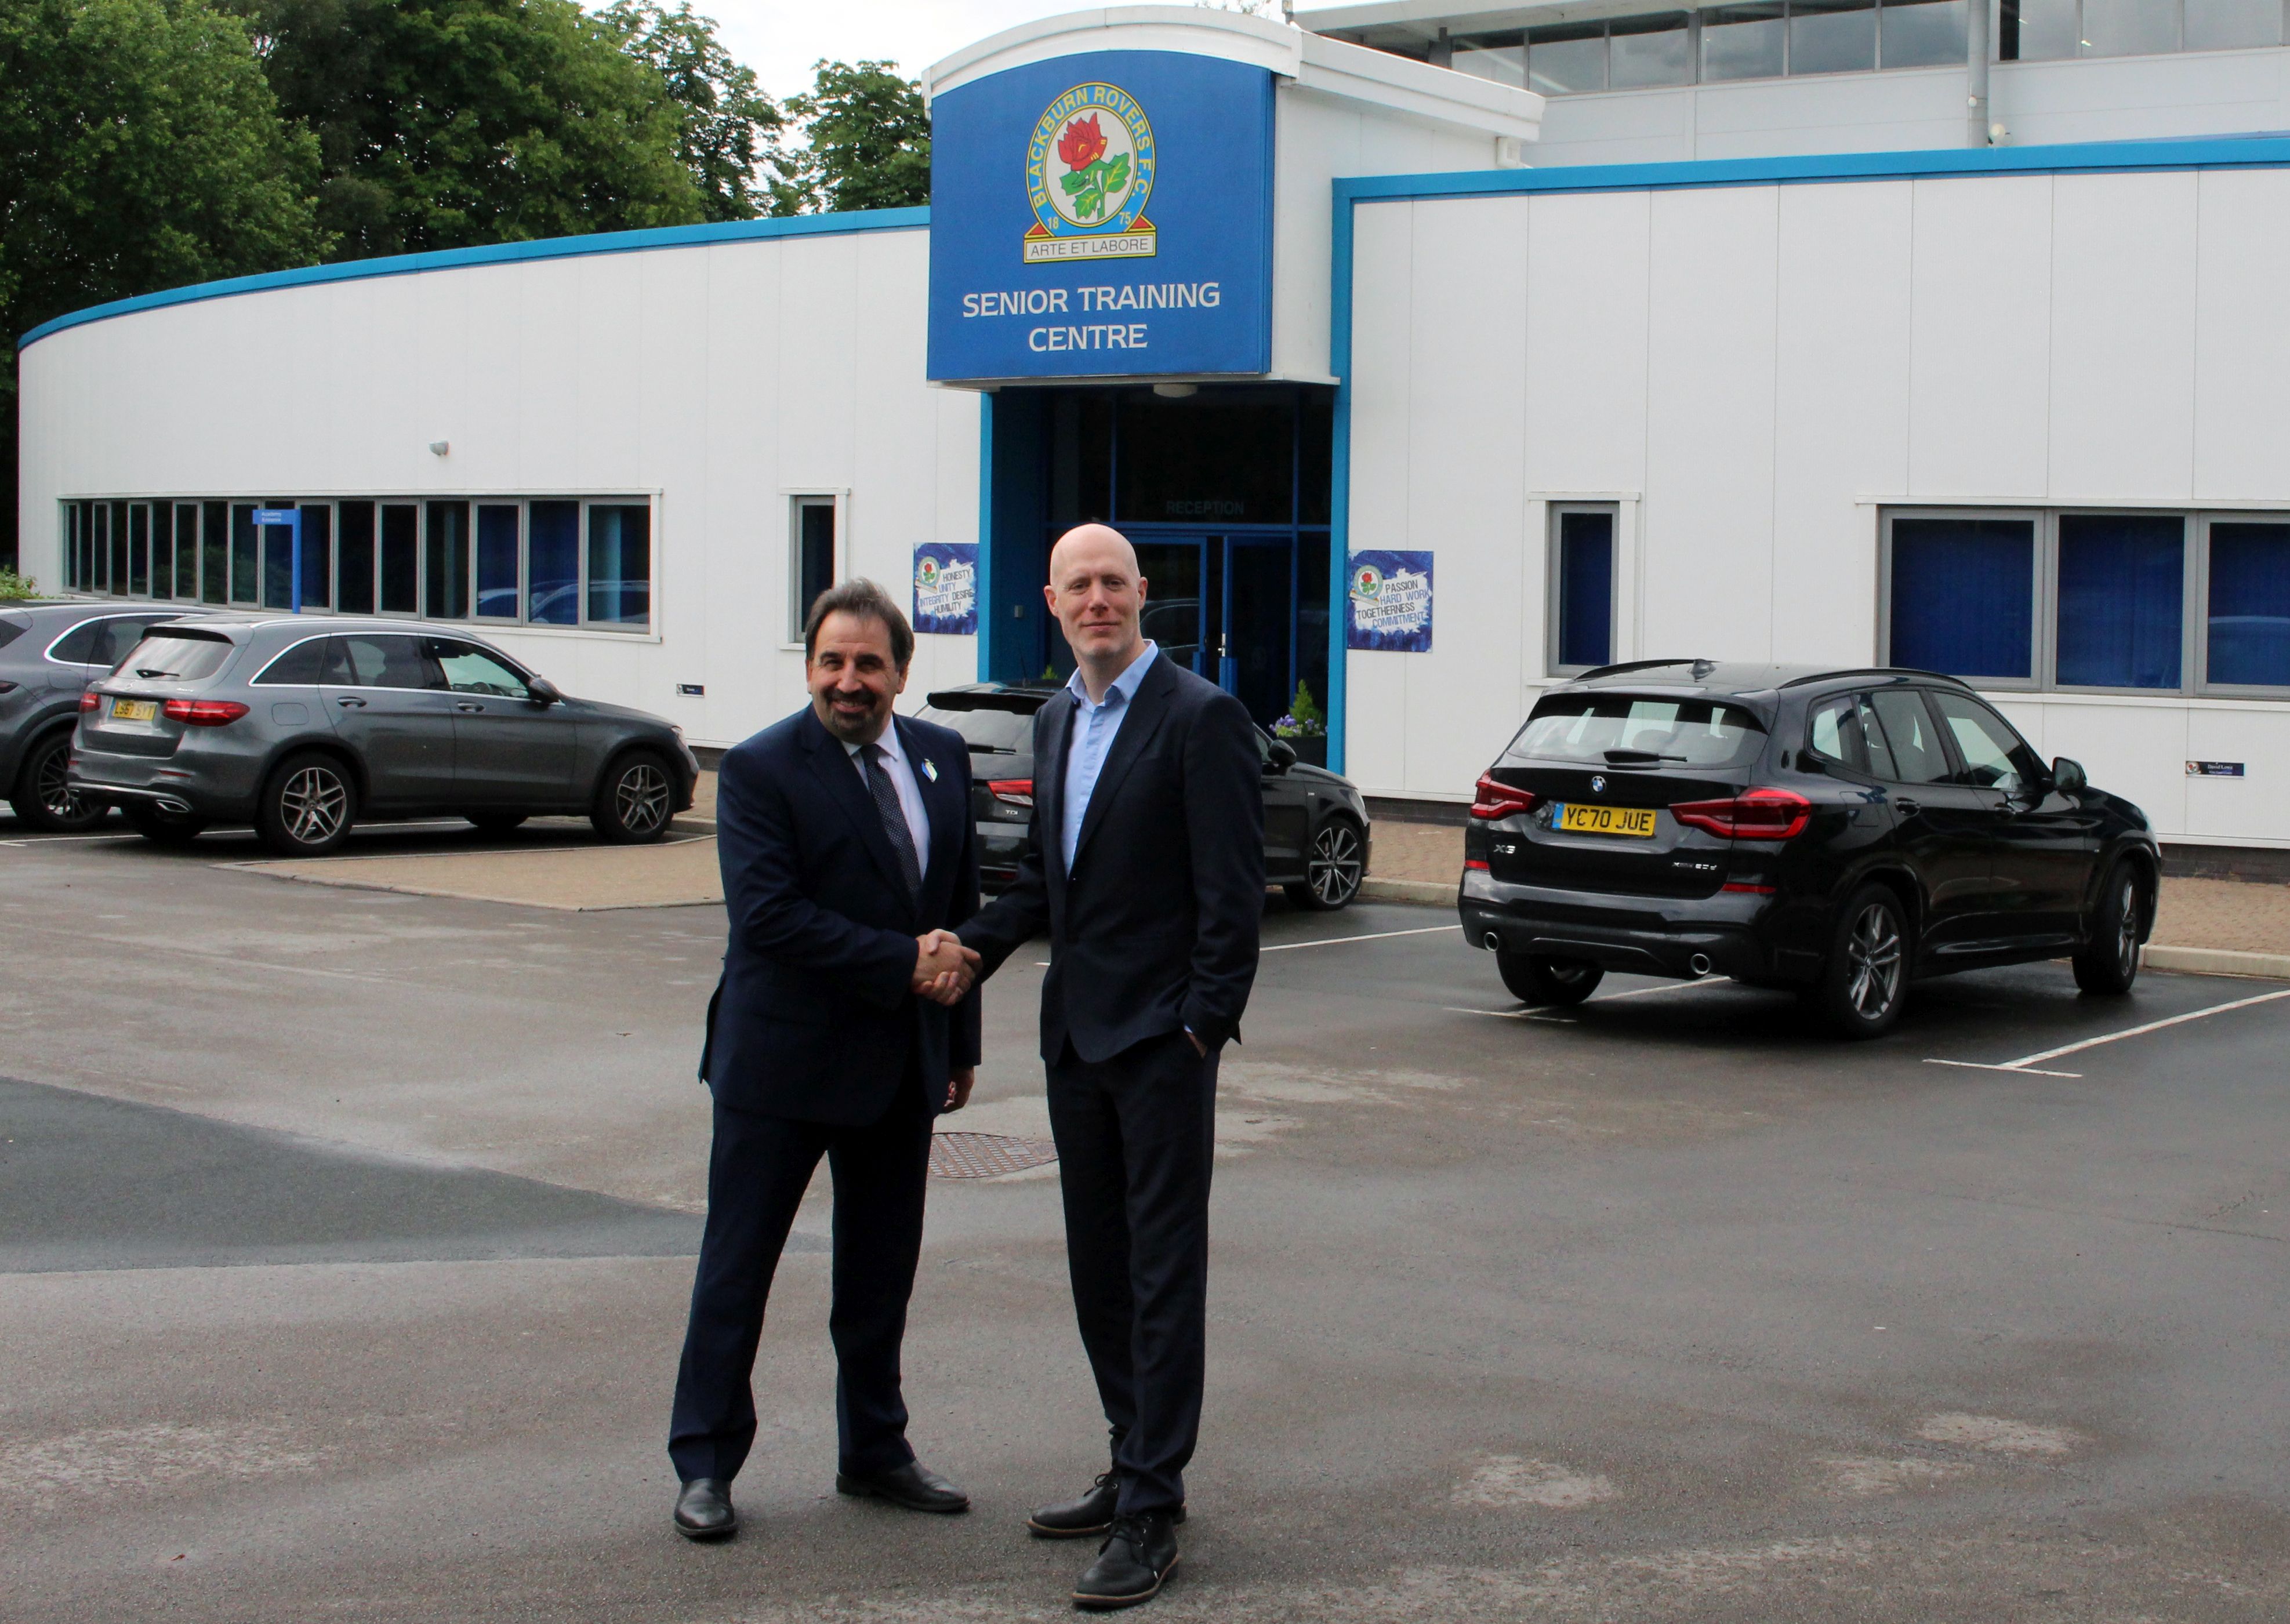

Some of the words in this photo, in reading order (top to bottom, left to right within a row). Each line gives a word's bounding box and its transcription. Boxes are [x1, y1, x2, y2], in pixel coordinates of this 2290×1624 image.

[1029, 87, 1088, 208] BLACKBURN
[1094, 86, 1151, 151] ROVERS
[1132, 158, 1152, 197] F.C.
[1047, 216, 1059, 230] 18
[1119, 212, 1131, 225] 75
[1031, 243, 1066, 256] ARTE
[1071, 242, 1088, 254] ET
[1092, 238, 1148, 253] LABORE
[963, 289, 1069, 318] SENIOR
[1077, 282, 1220, 311] TRAINING
[1029, 324, 1148, 352] CENTRE
[1166, 500, 1244, 515] RECEPTION
[943, 569, 971, 582] HONESTY
[939, 582, 956, 593] UNITY
[1385, 580, 1418, 594] PASSION
[920, 594, 949, 607] INTEGRITY
[952, 589, 974, 601] DESIRE
[1380, 594, 1402, 605] HARD
[1406, 589, 1430, 601] WORK
[934, 602, 962, 614] HUMILITY
[1357, 602, 1414, 619] TOGETHERNESS
[1373, 612, 1424, 627] COMMITMENT
[1567, 807, 1611, 828] YC70
[1616, 811, 1652, 831] JUE
[1493, 844, 1516, 854] X3
